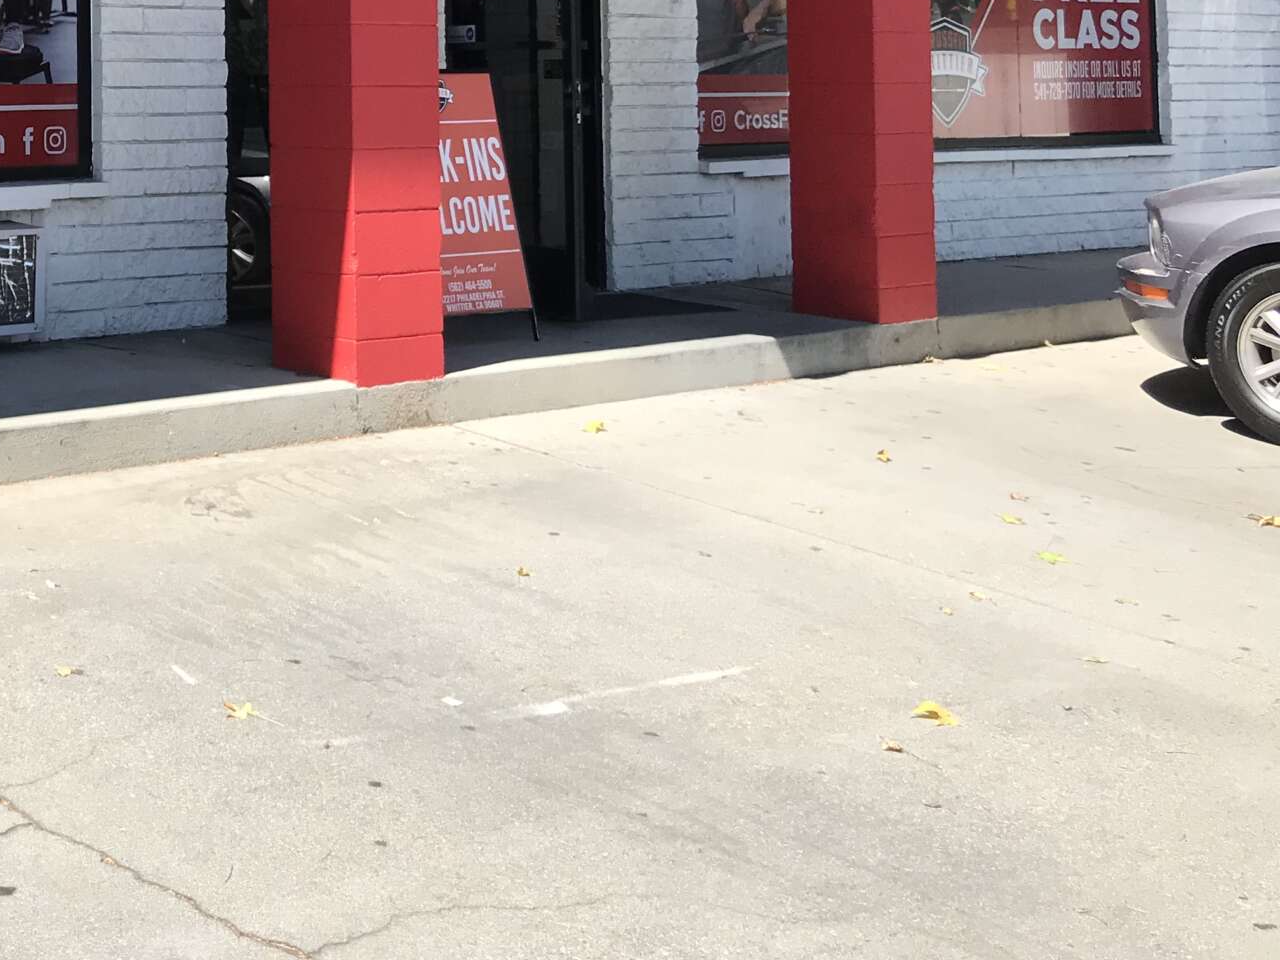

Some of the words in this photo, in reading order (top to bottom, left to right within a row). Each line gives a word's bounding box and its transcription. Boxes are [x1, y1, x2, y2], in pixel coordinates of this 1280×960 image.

[1032, 8, 1140, 51] CLASS
[1065, 60, 1089, 78] INSIDE
[1090, 60, 1101, 77] OR
[1102, 60, 1120, 77] CALL
[1121, 60, 1131, 77] US
[1132, 60, 1141, 77] AT
[1082, 82, 1095, 98] FOR
[1096, 82, 1115, 98] MORE
[1116, 81, 1142, 98] DETAILS
[734, 109, 789, 130] CrossF
[439, 136, 506, 183] K-INS
[439, 194, 515, 236] LCOME
